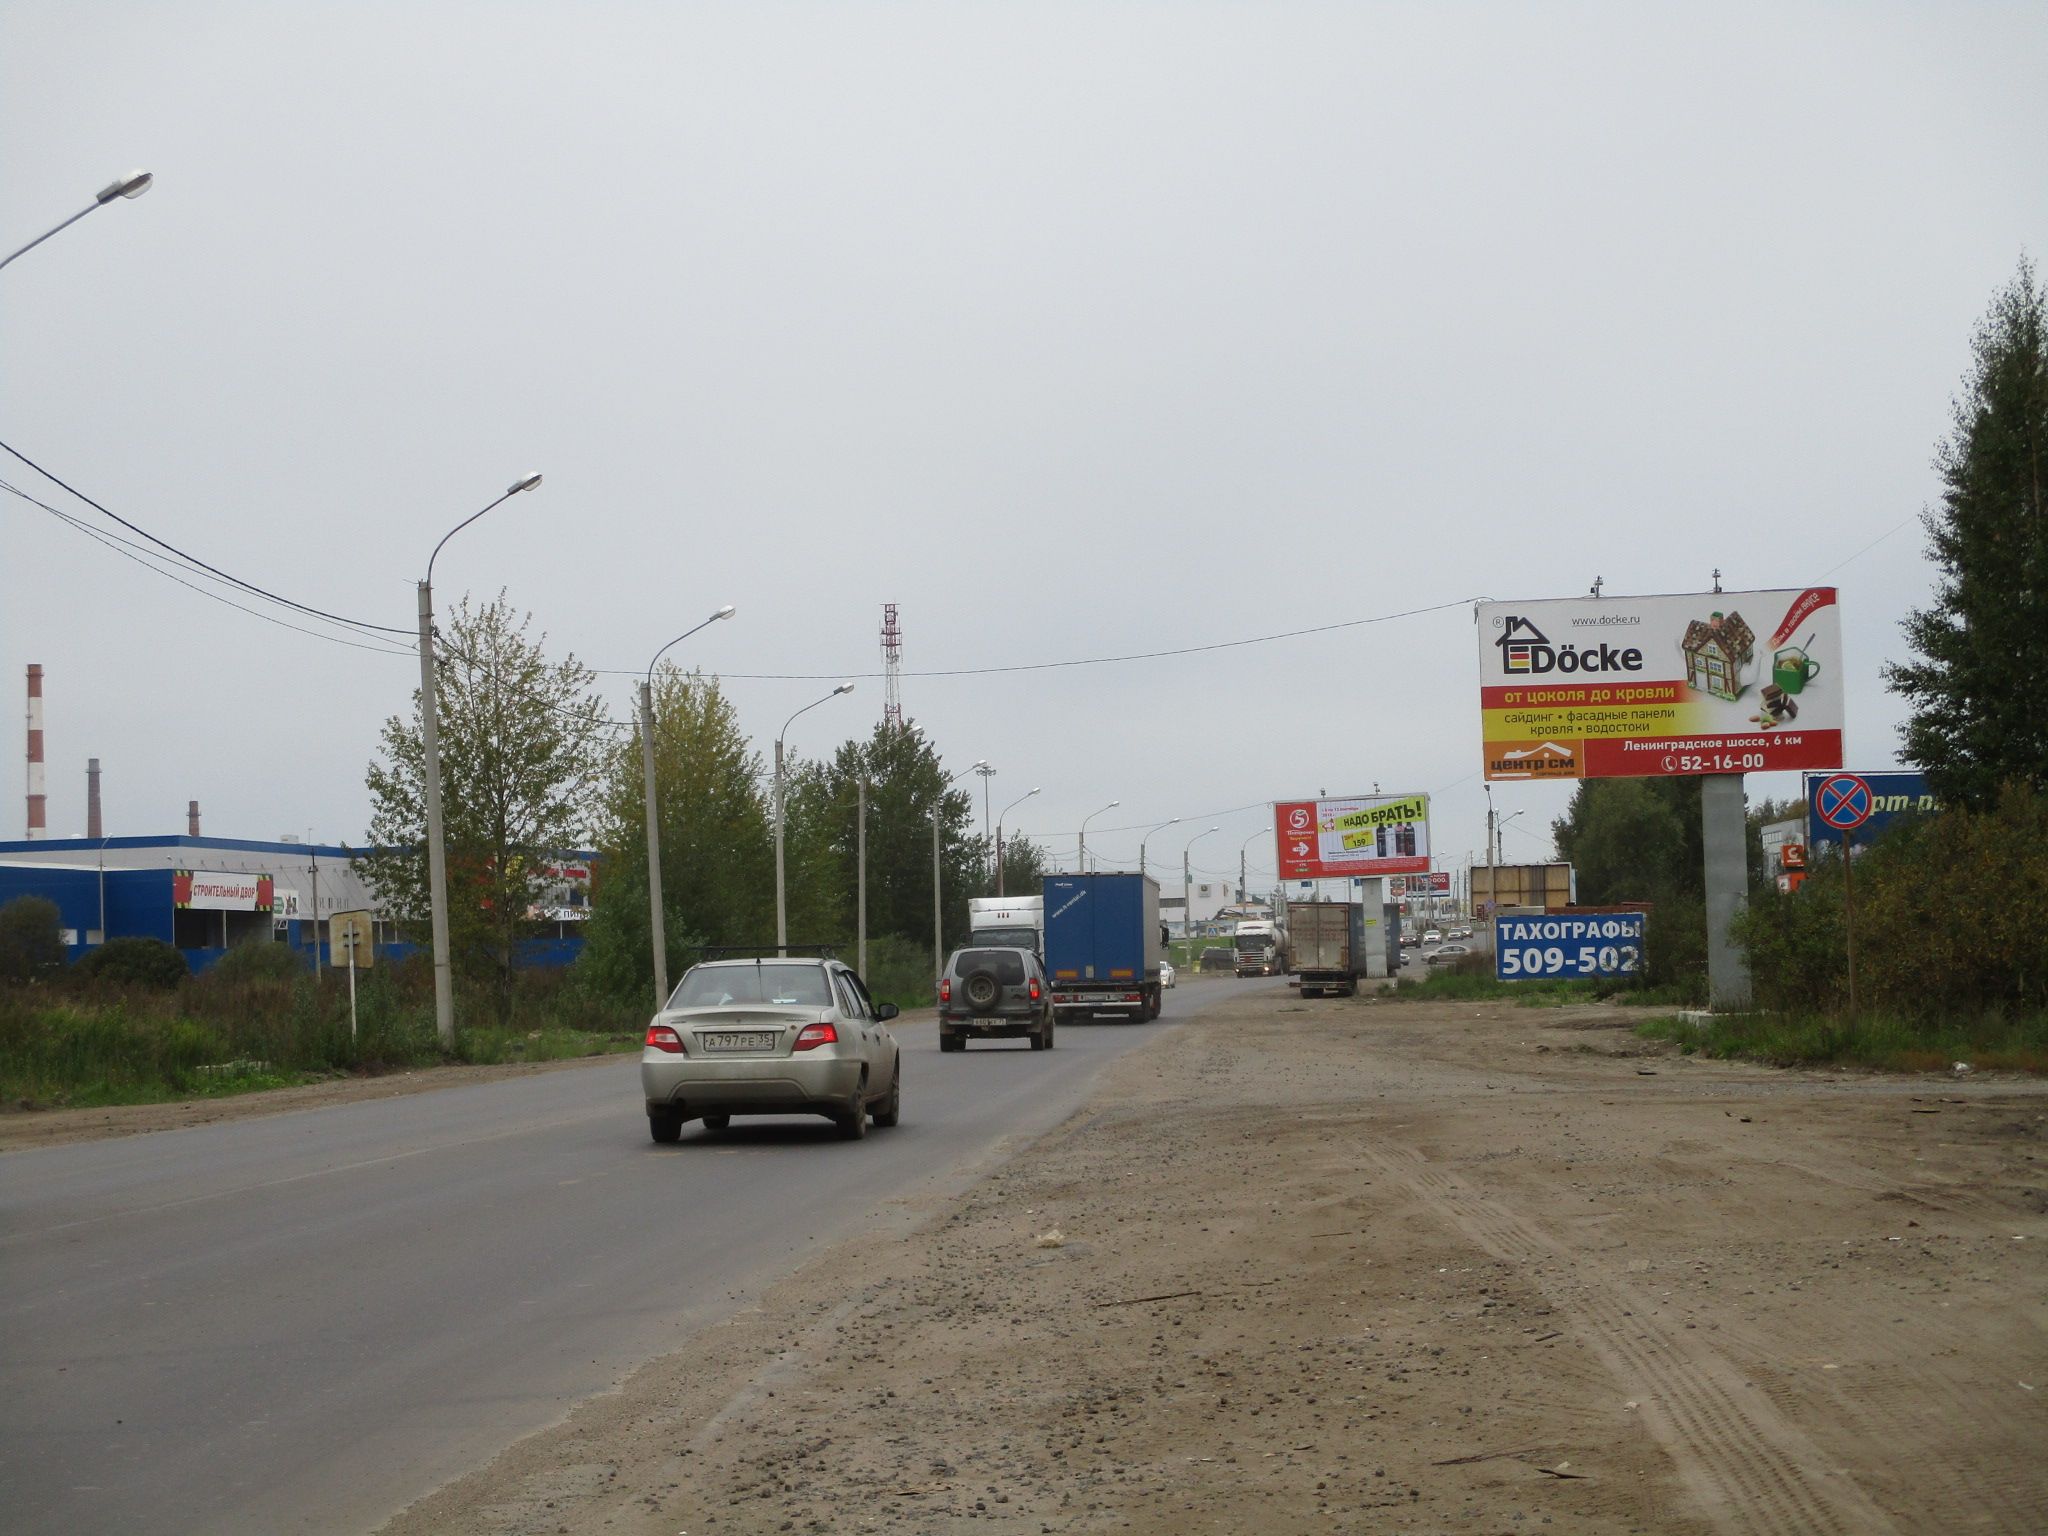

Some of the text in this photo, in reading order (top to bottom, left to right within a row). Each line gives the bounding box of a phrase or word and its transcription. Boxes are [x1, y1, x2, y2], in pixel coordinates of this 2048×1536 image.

[1800, 592, 1821, 611] вкусе
[1571, 614, 1641, 626] www.docke.ru
[1531, 643, 1643, 674] Döcke
[1504, 687, 1676, 705] от цоколя до кровли
[1504, 709, 1675, 724] сайдинг фасадные панели
[1530, 722, 1650, 736] кровля водостоки
[1623, 735, 1802, 752] Ленинградское шоссе, 6 км
[1680, 753, 1765, 771] 52-16-00
[1343, 800, 1422, 828] НАДО БРАТЬ!
[1352, 838, 1366, 847] 159
[193, 884, 256, 901] СТРОИТЕЛЬНЫЙ ДВОР
[1499, 920, 1641, 941] ТАХОГРАФЫ
[1502, 945, 1640, 975] 509-502
